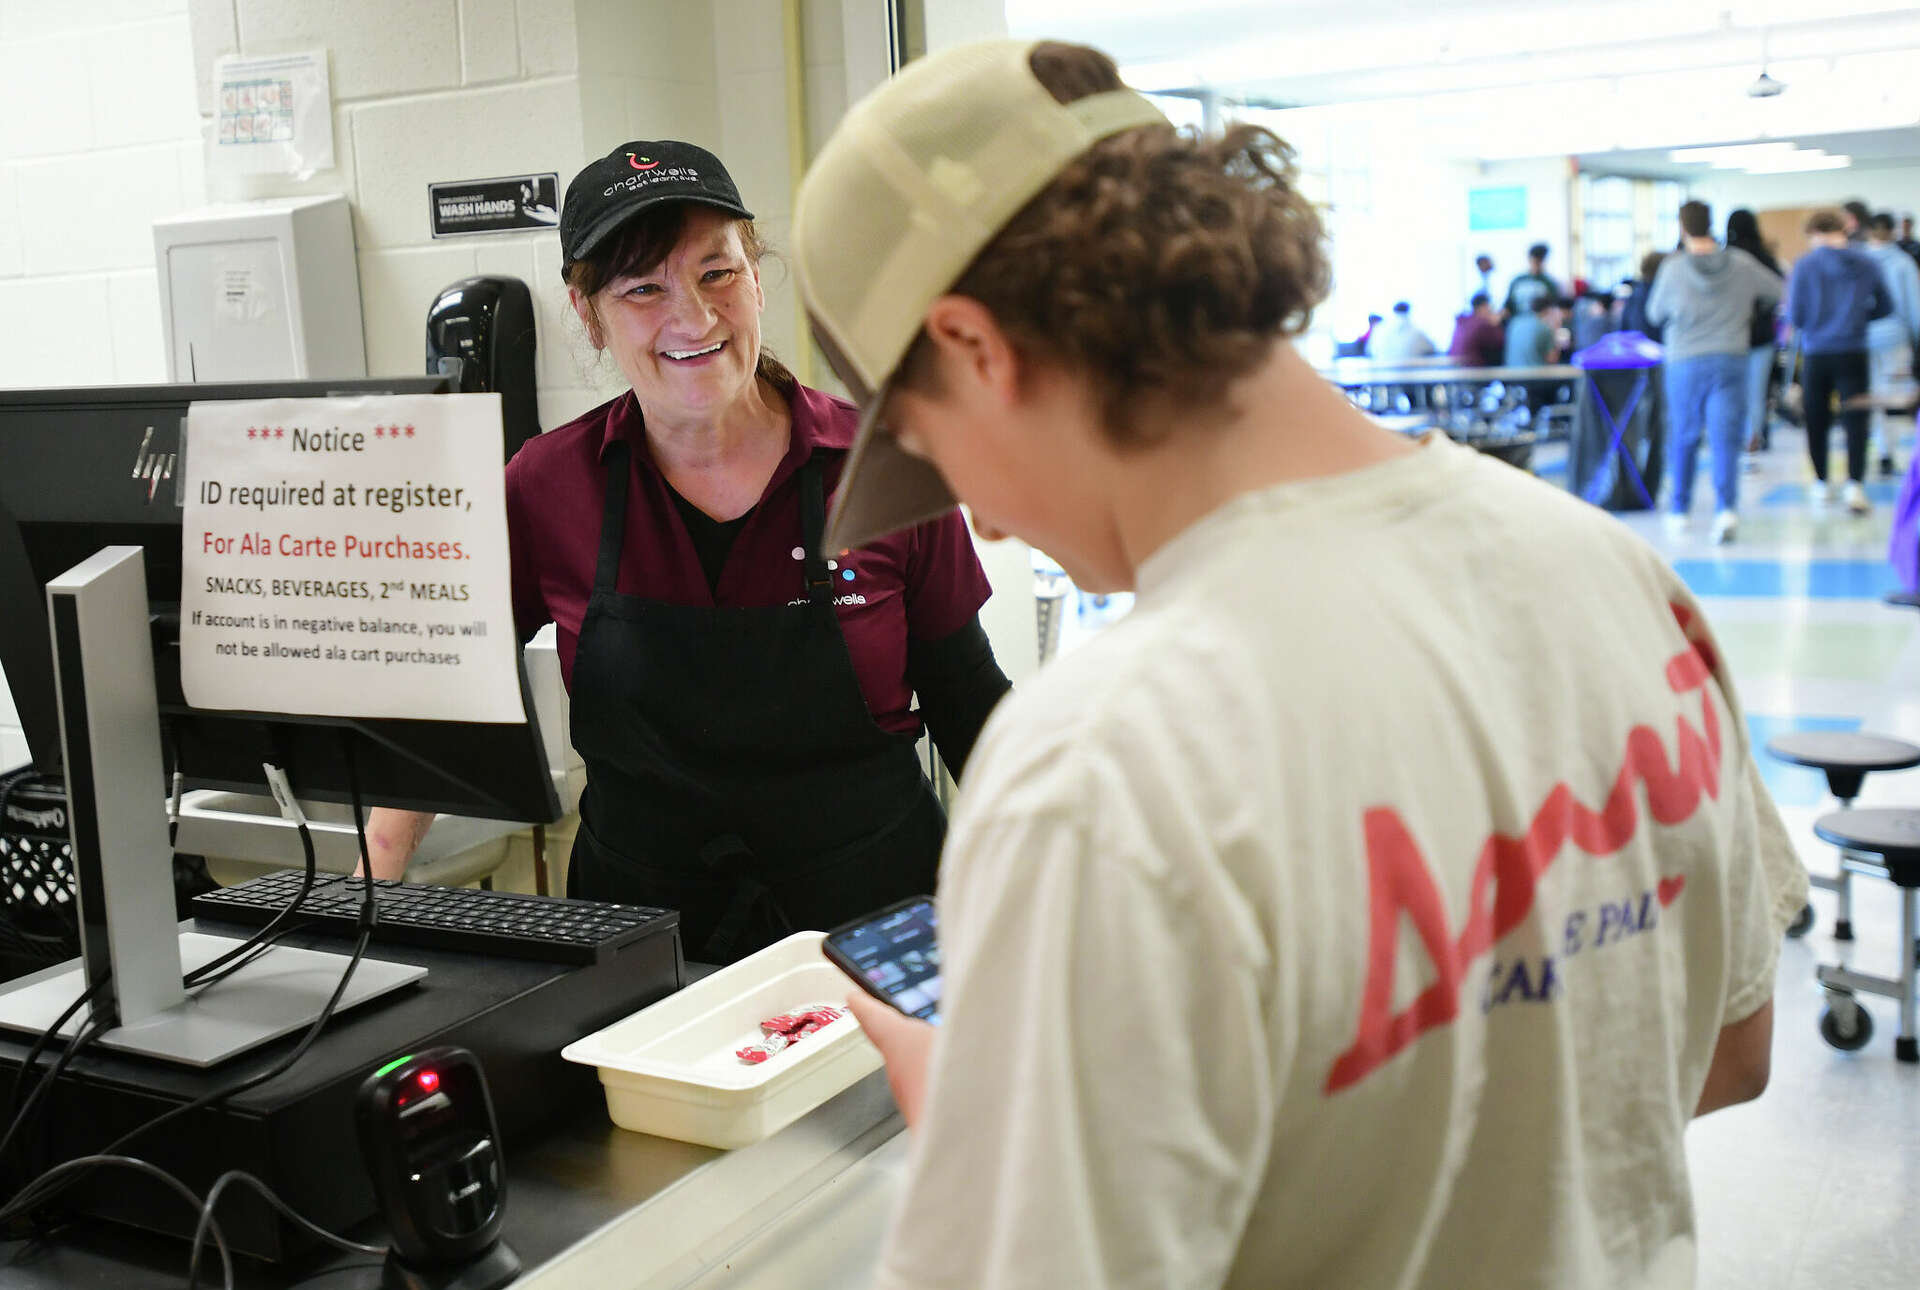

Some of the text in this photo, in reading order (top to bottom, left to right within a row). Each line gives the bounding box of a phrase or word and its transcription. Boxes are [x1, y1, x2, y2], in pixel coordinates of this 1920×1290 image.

[603, 167, 699, 196] chartwells
[439, 202, 474, 217] WASH
[474, 199, 516, 214] HANDS
[293, 426, 365, 452] Notice
[200, 480, 472, 513] ID required at register,
[203, 532, 470, 560] For Ala Carte Purchases.
[206, 576, 470, 602] SNACKS, BEVERAGES, 2nd MEALS
[191, 610, 487, 638] If account is in negative balance, you will
[216, 641, 461, 666] not be allowed ala cart purchases
